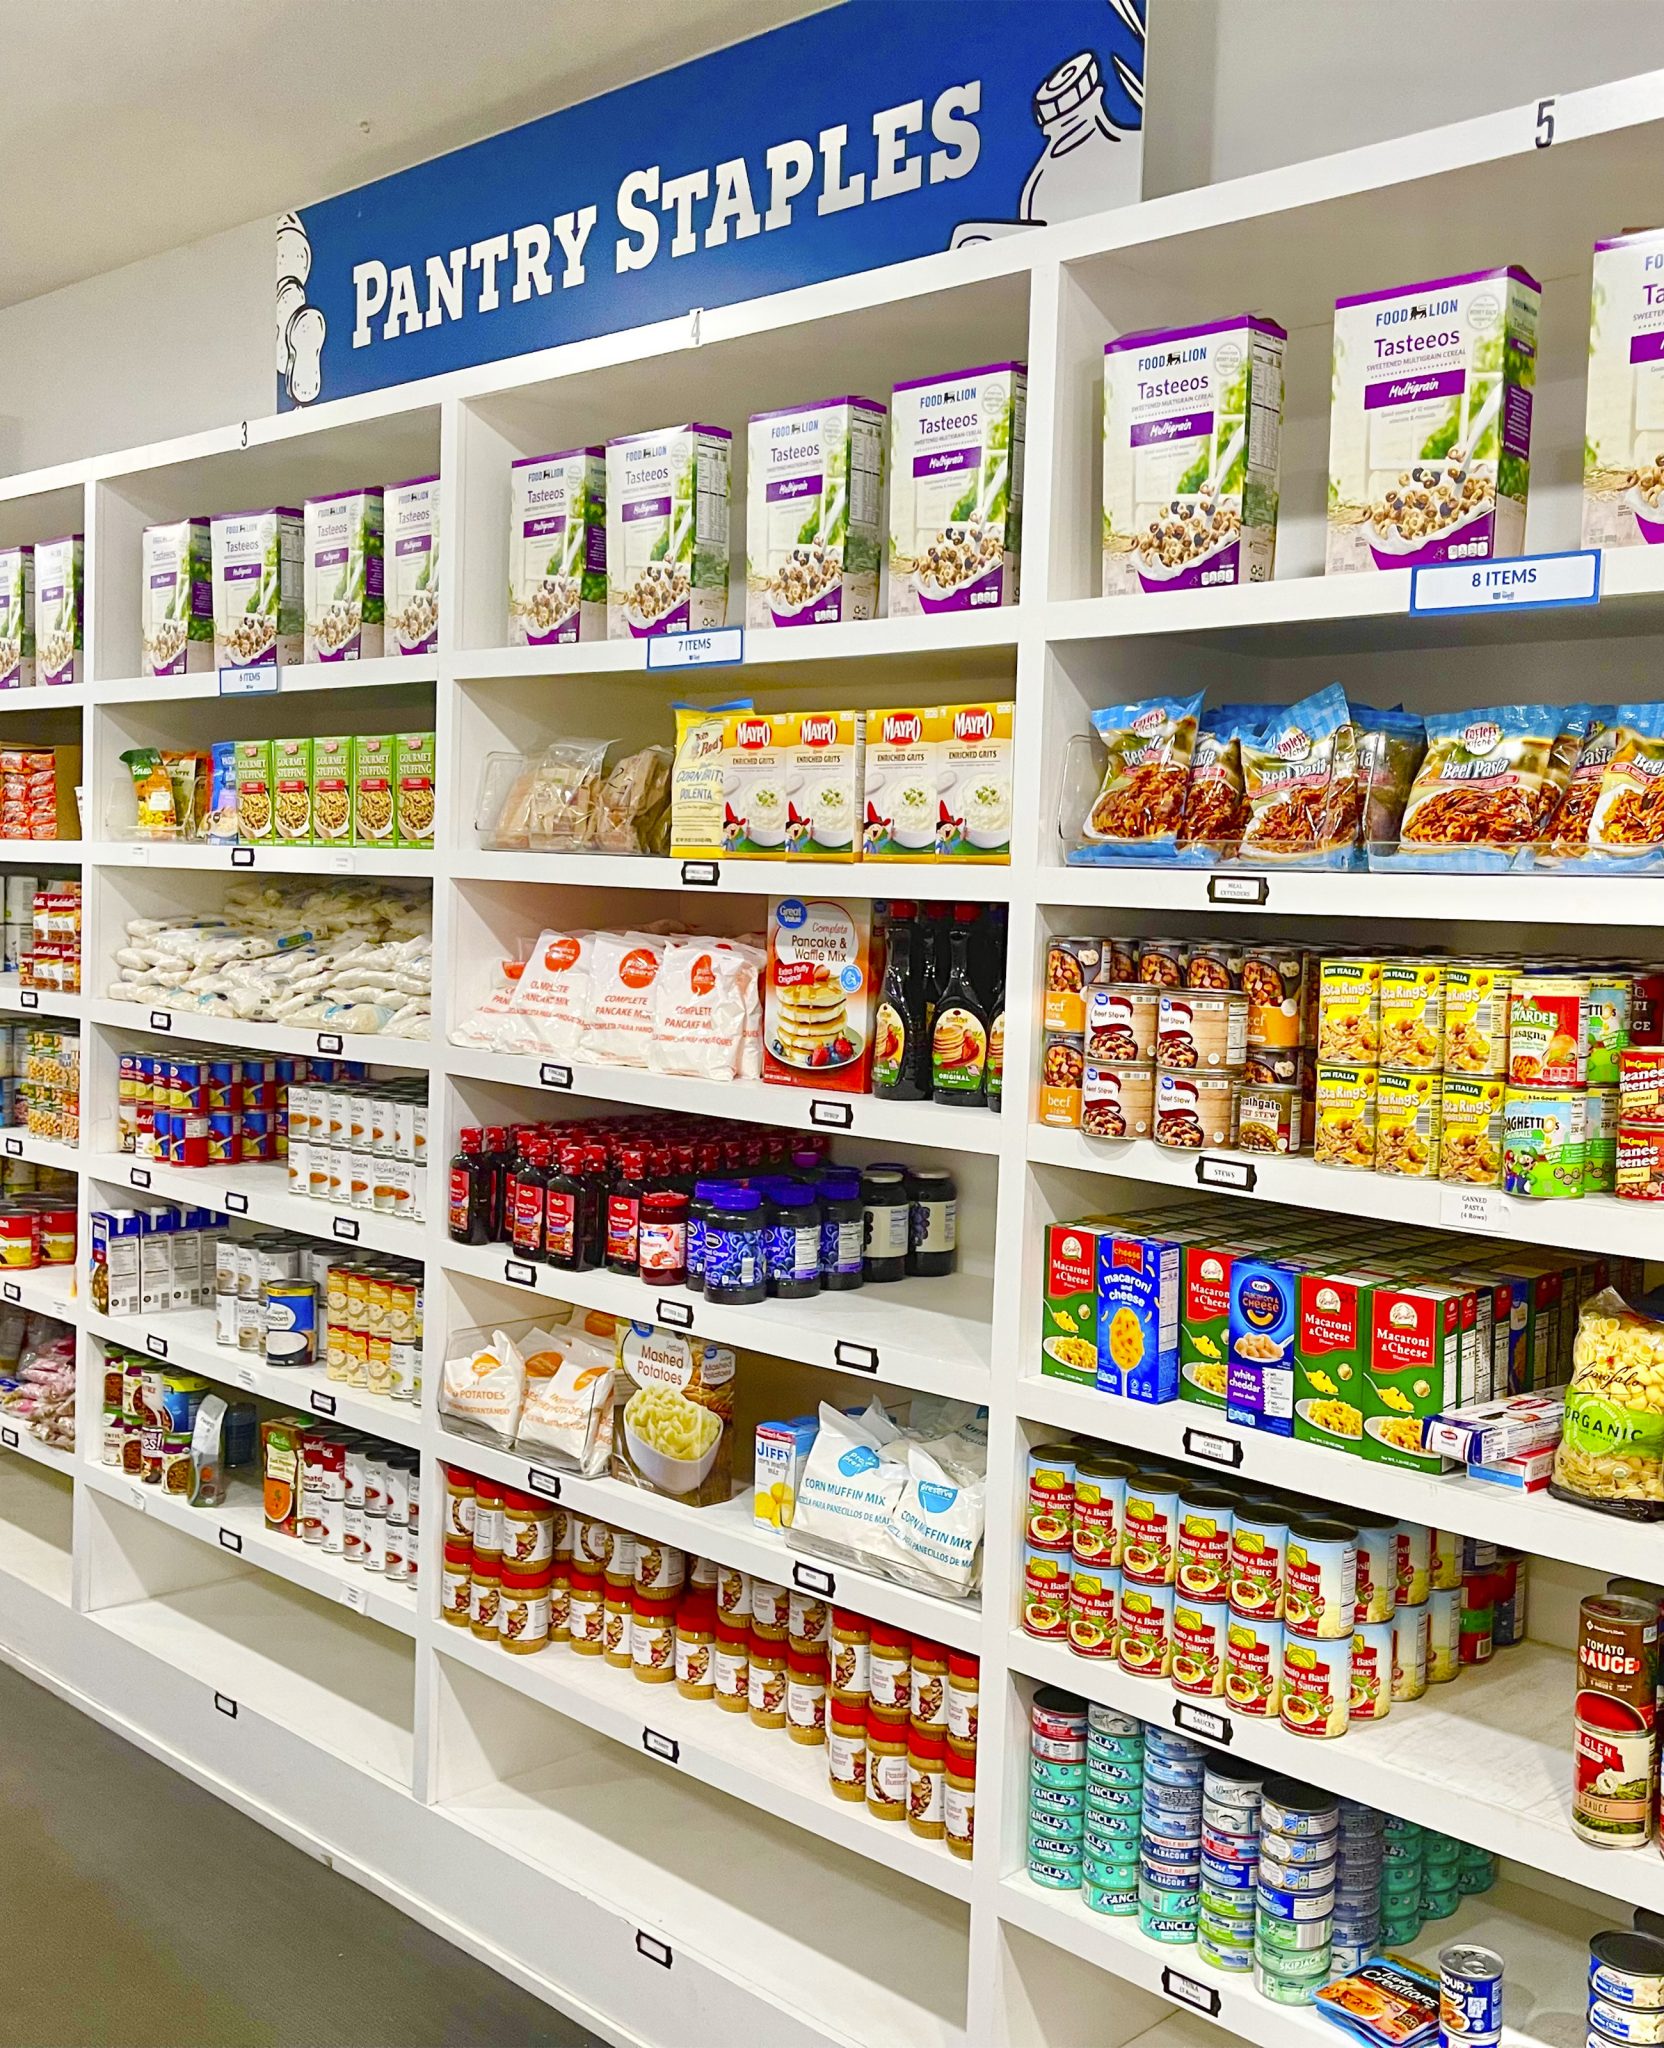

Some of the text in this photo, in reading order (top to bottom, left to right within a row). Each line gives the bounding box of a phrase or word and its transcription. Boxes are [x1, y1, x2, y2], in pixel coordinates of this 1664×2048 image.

[1535, 100, 1555, 148] 5
[352, 80, 983, 349] PANTRY STAPLES
[1376, 309, 1407, 327] FOOD
[1429, 300, 1458, 317] LION
[691, 310, 702, 346] 4
[1374, 330, 1459, 357] Tasteeos
[1138, 347, 1207, 372] FOOD LION
[1367, 349, 1466, 371] SWEETENED MULTIGRAIN CEREAL
[1138, 376, 1208, 400] Tasteeos
[1389, 378, 1438, 398] Multigrain
[921, 388, 976, 408] FOOD LION
[1161, 396, 1193, 408] MULTIGRAIN
[1194, 392, 1214, 403] CEREAL
[772, 420, 818, 439] FOOD LION
[919, 414, 977, 435] Tasteeos
[1150, 418, 1191, 437] Multigrain
[241, 420, 248, 448] 3
[626, 445, 666, 462] FOOD LION
[771, 443, 819, 462] Tasteeos
[929, 454, 963, 470] Multigrain
[626, 468, 668, 485] Tasteeos
[528, 488, 564, 503] Tasteeos
[1472, 569, 1537, 587] 8 ITEMS
[678, 637, 711, 651] 7 ITEMS
[801, 718, 836, 745] MAYPO
[883, 716, 921, 743] MAYPO
[955, 712, 993, 740] MAYPO
[737, 723, 770, 747] MAYPO
[317, 756, 346, 765] GOURMET
[359, 754, 389, 764] GOURMET
[400, 753, 431, 762] GOURMET
[877, 754, 905, 762] ENRICHED
[978, 750, 997, 758] GRITS
[238, 759, 266, 768] GOURMET
[277, 758, 306, 767] GOURMET
[400, 764, 432, 774] STUFFING
[1440, 758, 1509, 779] Beef Pasta
[238, 769, 266, 779] STUFFING
[277, 768, 306, 777] STUFFING
[317, 766, 346, 777] STUFFING
[359, 765, 390, 776] STUFFING
[1262, 759, 1327, 786] Beef Pasta
[780, 905, 801, 917] Great
[813, 923, 848, 937] Complete
[792, 935, 847, 948] Pancake &
[795, 949, 846, 962] Waffle Mix
[779, 965, 809, 975] Extra Fluffy
[1392, 972, 1415, 980] ITALIA
[778, 974, 802, 984] Original
[604, 995, 647, 1006] COMPLETE
[595, 1008, 634, 1017] PANCAKE
[939, 1073, 970, 1081] ORIGINAL
[1333, 1072, 1355, 1081] ITALIA
[1386, 1078, 1407, 1087] ITALIA
[1455, 1086, 1479, 1094] ITALIA
[1241, 1096, 1281, 1112] uthgate
[1254, 1110, 1277, 1120] STEW
[1214, 1168, 1235, 1179] STEWS
[1462, 1195, 1487, 1204] CANNED
[1464, 1204, 1485, 1212] PASTA
[1053, 1259, 1090, 1275] Macaroni
[1104, 1273, 1152, 1294] macaroni
[1120, 1284, 1132, 1292] and
[1252, 1281, 1268, 1291] Kraft
[1109, 1290, 1145, 1307] cheese
[1305, 1312, 1352, 1334] Macaroni
[1377, 1328, 1430, 1348] Macaroni
[641, 1346, 684, 1368] Mashed
[637, 1361, 682, 1386] Potatoes
[704, 1361, 732, 1372] Mashed
[1233, 1369, 1256, 1381] white
[1229, 1378, 1261, 1394] cheddar
[460, 1390, 505, 1399] POTATOES
[1565, 1406, 1643, 1441] ORGANIC
[805, 1478, 886, 1506] CORN MUFFIN MIX
[812, 1499, 874, 1521] PARA PANECILLOS DE
[1085, 1516, 1108, 1527] Sauce
[1147, 1523, 1167, 1535] Basil
[950, 1537, 972, 1550] MIX
[1139, 1532, 1162, 1543] Sauce
[911, 1542, 960, 1566] PANECILLOS DE
[1196, 1548, 1223, 1560] Sauce
[1208, 1542, 1229, 1553] Basil
[1257, 1557, 1278, 1570] Basil
[1249, 1566, 1272, 1577] Sauce
[1302, 1573, 1321, 1584] Basil
[1586, 1637, 1624, 1656] TOMATO
[1580, 1645, 1635, 1675] SAUCE
[1308, 1672, 1329, 1683] Basil
[1299, 1681, 1324, 1693] Sauce
[1584, 1736, 1612, 1757] GLEN
[1584, 1799, 1609, 1814] SAUCE
[1153, 1849, 1188, 1860] ALBACORE
[1150, 1874, 1185, 1886] ALBACORE
[1280, 1958, 1320, 1970] SKIPJACK
[1382, 1968, 1413, 1987] Tuna
[1362, 1970, 1439, 2008] Creations
